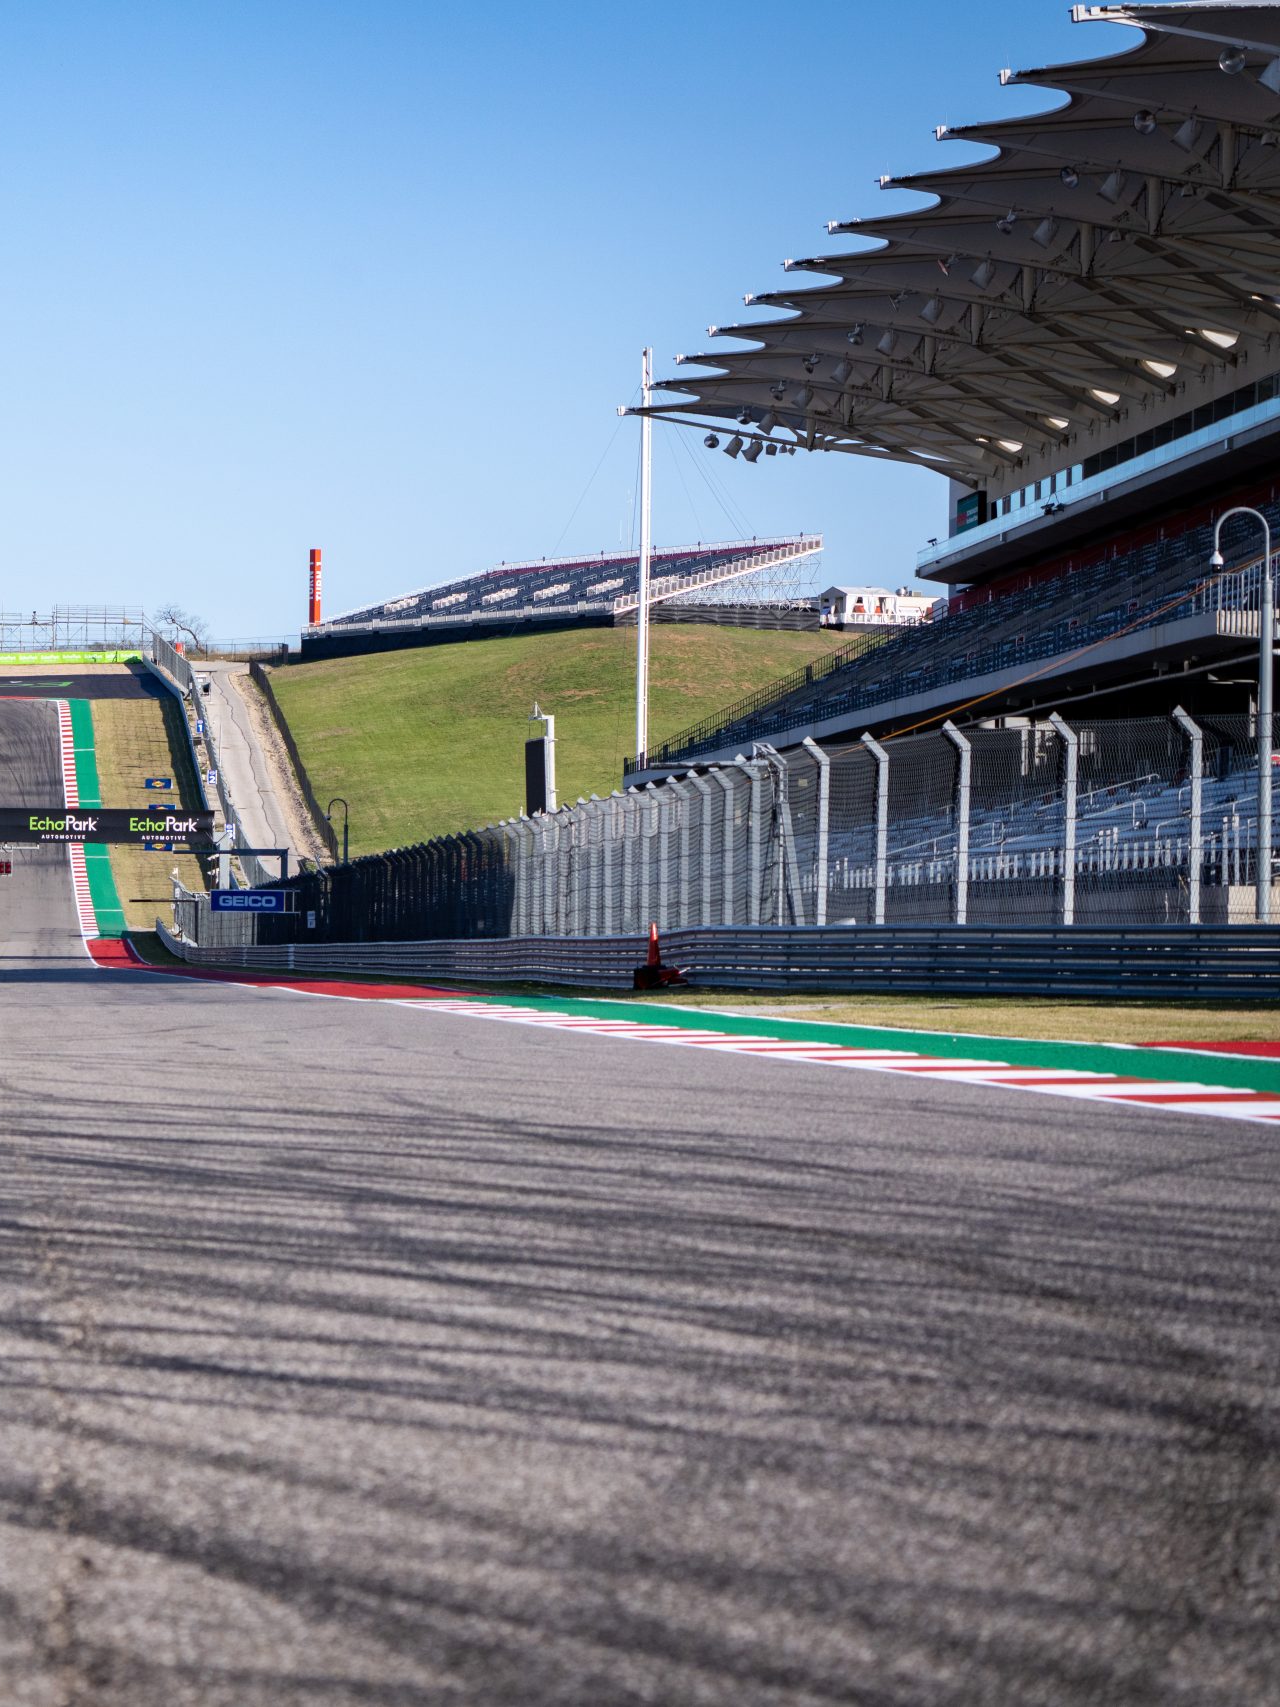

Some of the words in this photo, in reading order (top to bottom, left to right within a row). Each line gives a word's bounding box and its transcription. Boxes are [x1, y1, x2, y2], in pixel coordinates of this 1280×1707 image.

[210, 775, 216, 784] 2
[29, 815, 97, 831] EchoPark
[129, 816, 197, 832] EchoPark
[219, 895, 276, 907] GEICO
